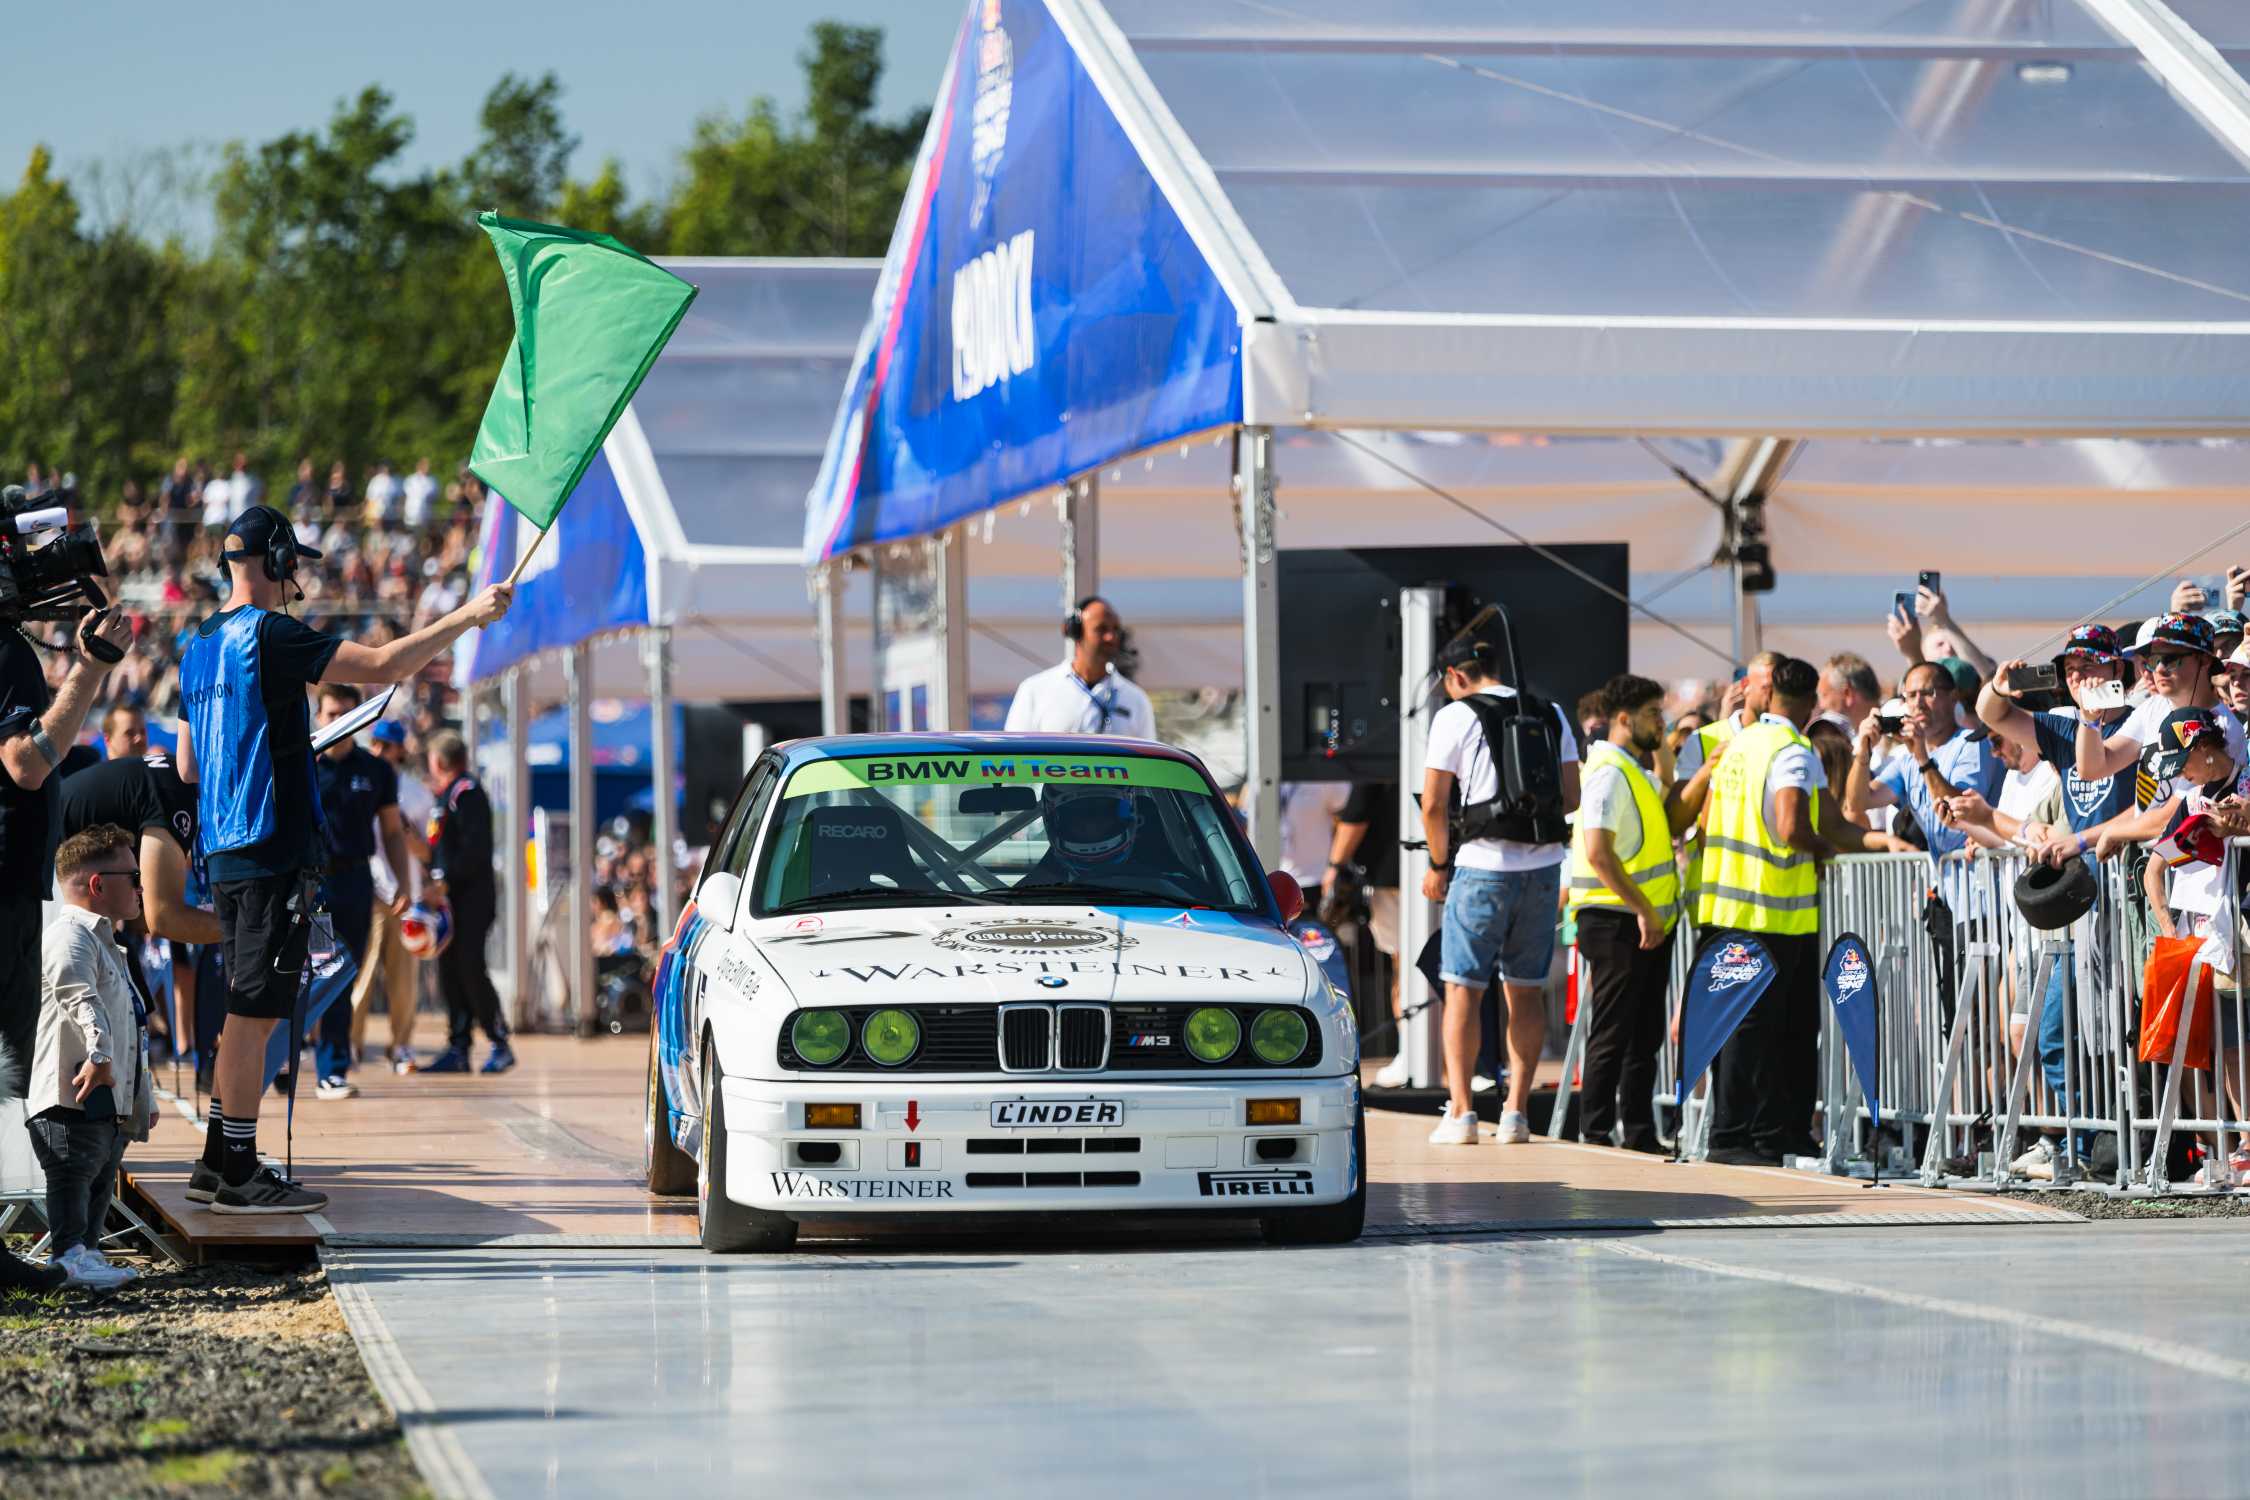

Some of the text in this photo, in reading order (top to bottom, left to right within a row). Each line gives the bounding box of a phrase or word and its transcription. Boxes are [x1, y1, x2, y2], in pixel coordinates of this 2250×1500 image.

[868, 760, 1130, 781] BMW M Team
[818, 825, 888, 839] RECARO
[841, 960, 1256, 983] WARSTEINER
[1139, 1035, 1170, 1047] M3
[997, 1104, 1118, 1123] LINDER
[770, 1171, 954, 1198] WARSTEINER
[1197, 1169, 1314, 1196] PIRELLI
